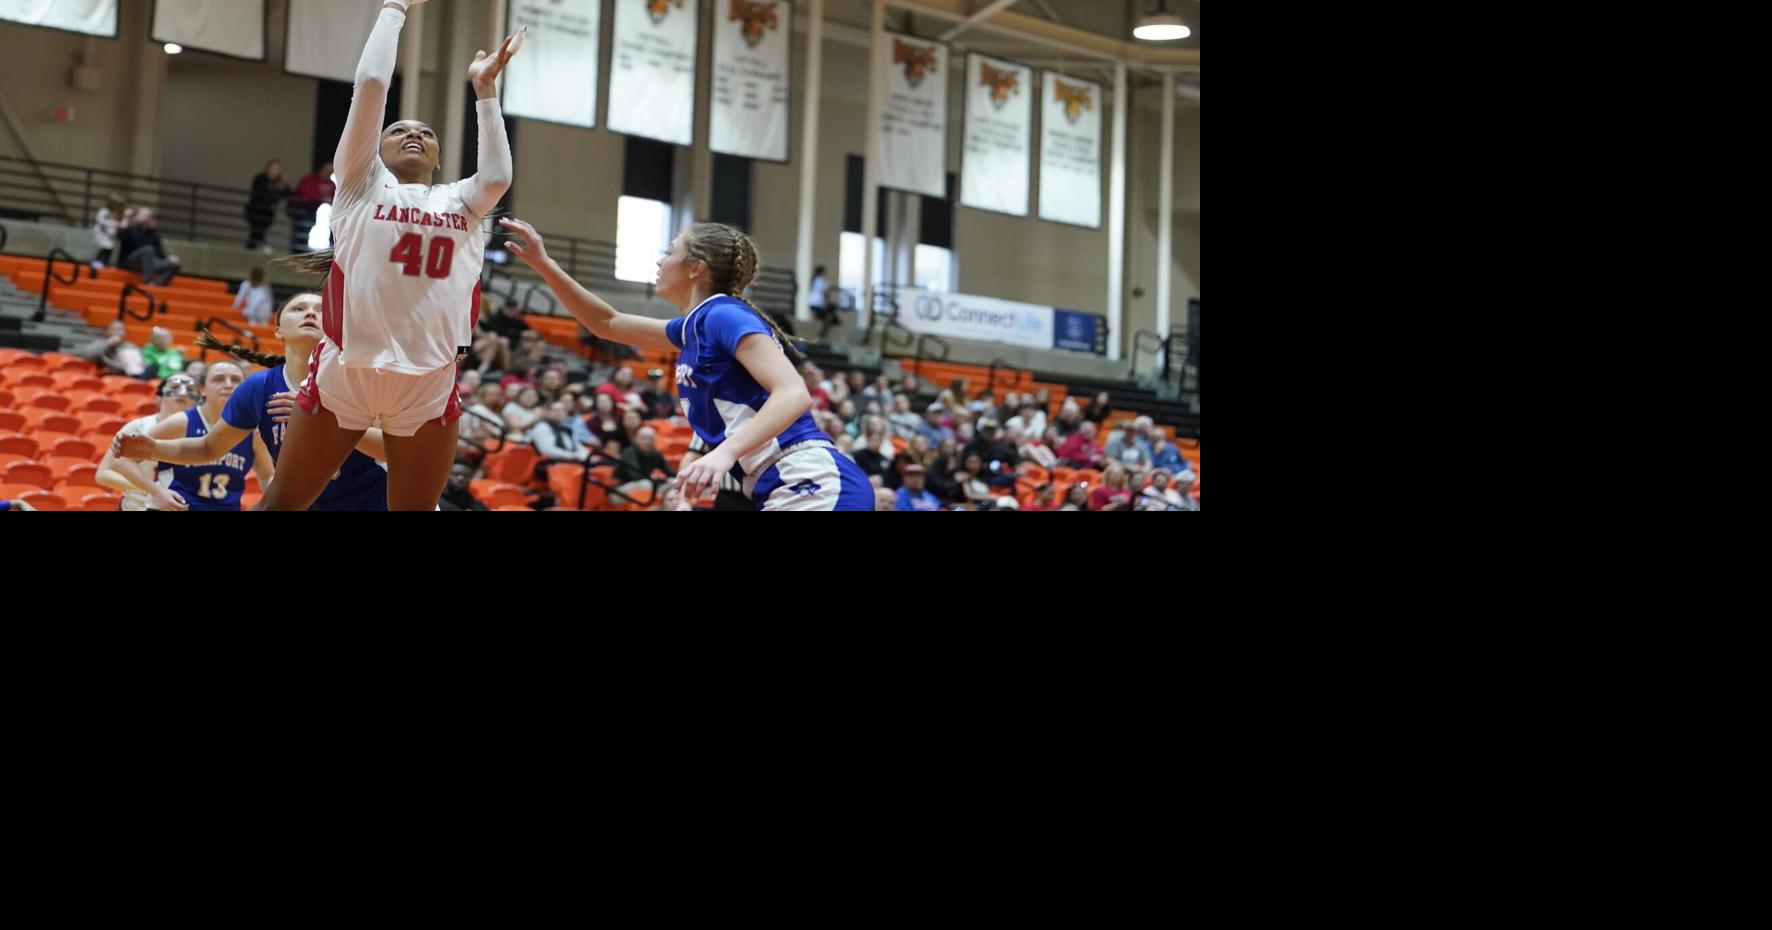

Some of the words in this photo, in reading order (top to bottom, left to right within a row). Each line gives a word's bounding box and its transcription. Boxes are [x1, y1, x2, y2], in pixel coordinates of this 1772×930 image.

[373, 204, 468, 232] LANCASTER
[389, 231, 455, 279] 40
[197, 473, 230, 499] 13
